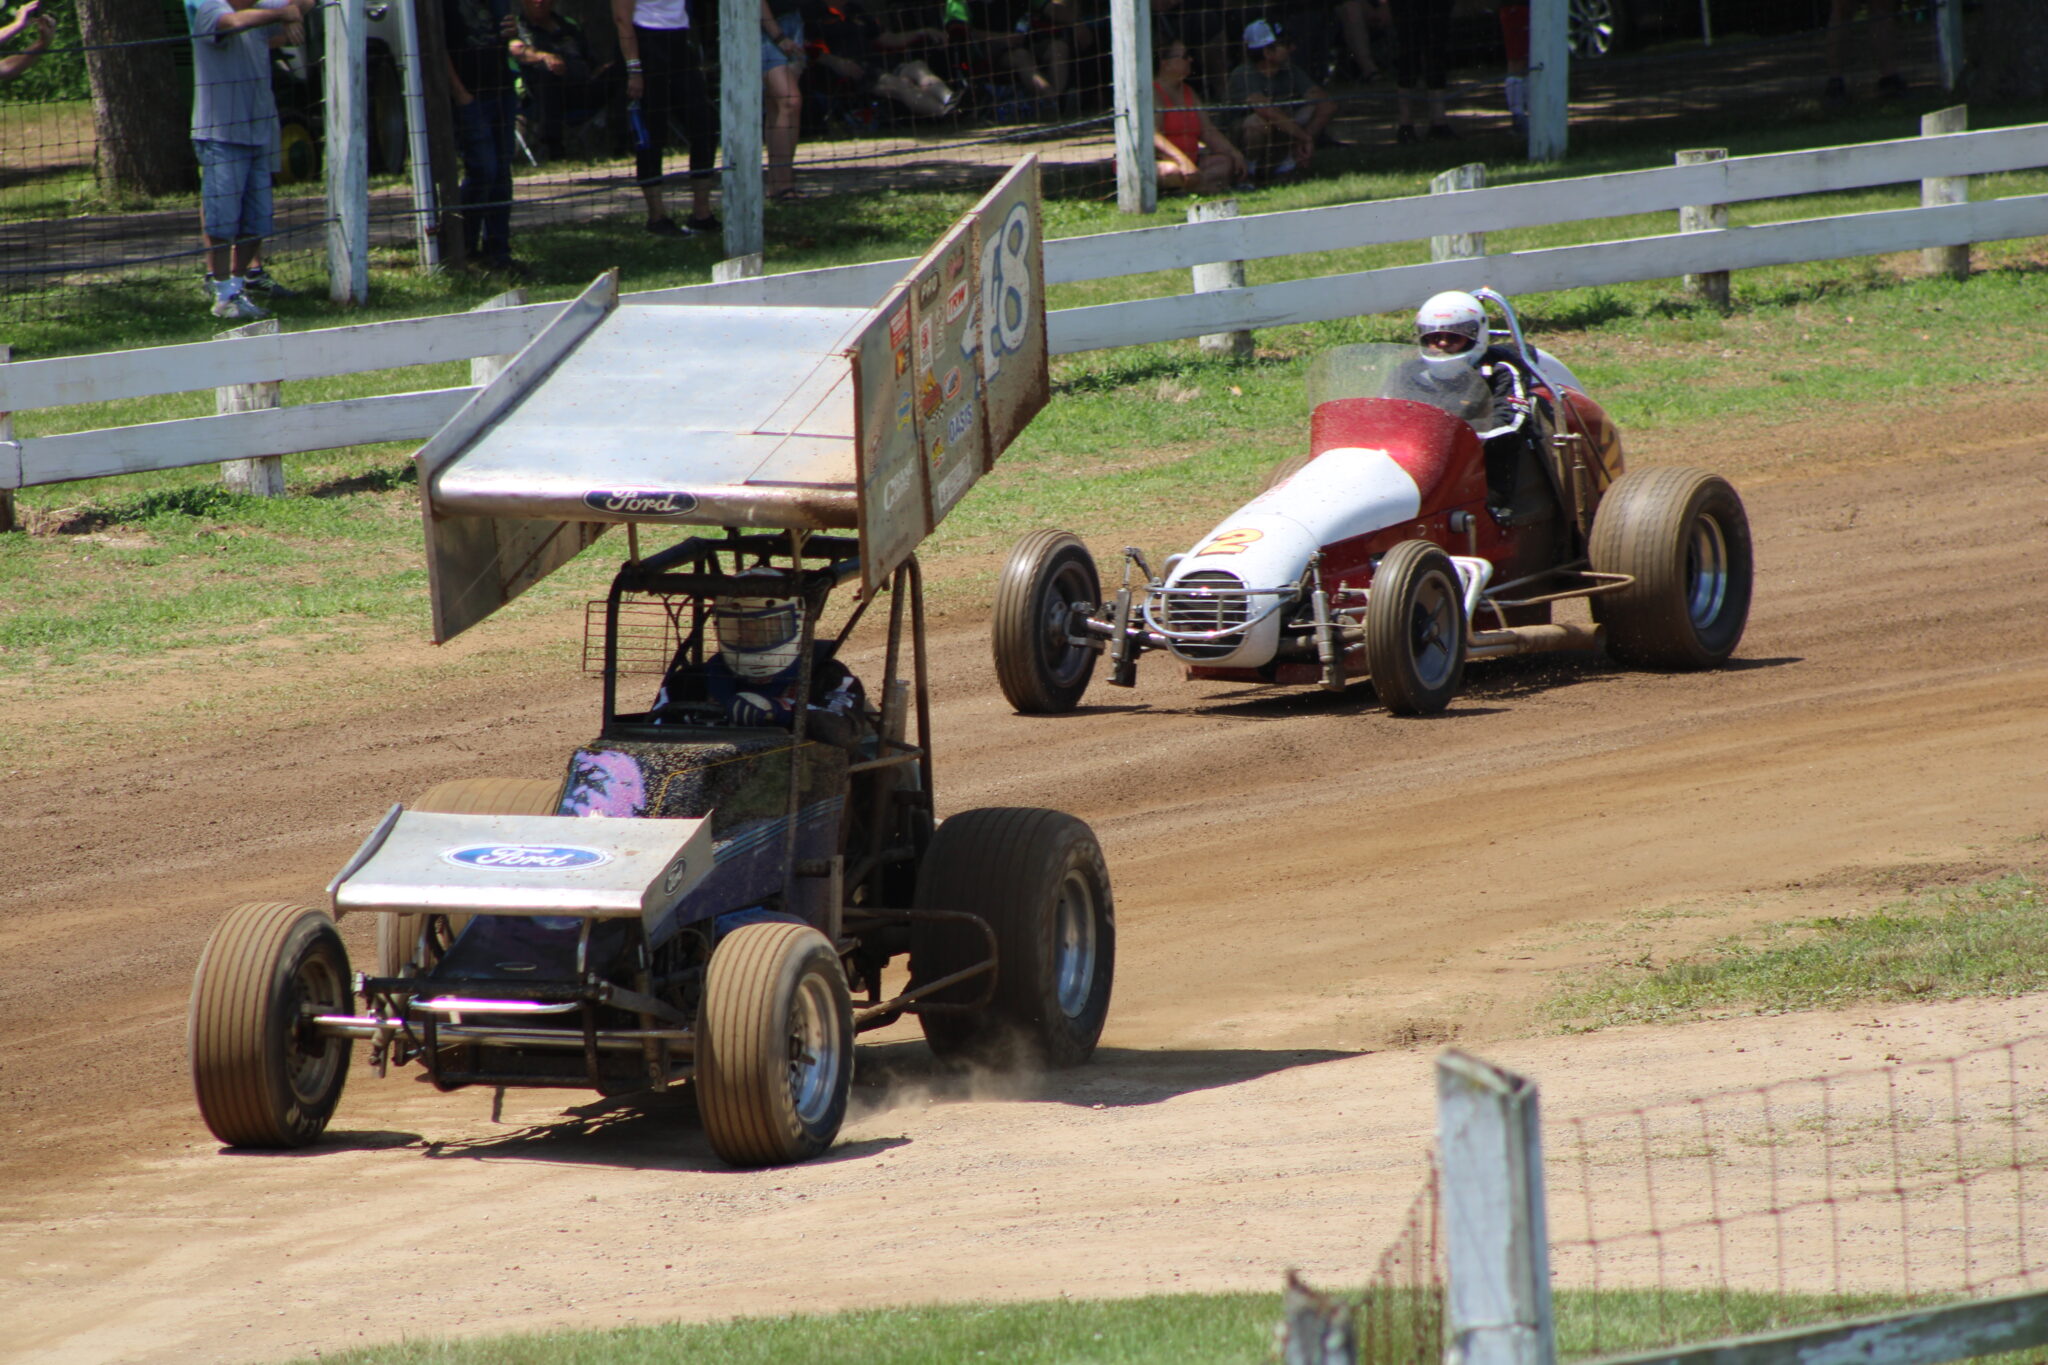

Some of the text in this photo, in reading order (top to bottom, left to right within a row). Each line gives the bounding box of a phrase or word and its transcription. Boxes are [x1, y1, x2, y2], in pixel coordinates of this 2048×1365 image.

[949, 283, 967, 315] TRW
[948, 401, 973, 446] OASIS
[606, 490, 681, 511] Ford
[1194, 528, 1264, 558] 2
[475, 847, 574, 866] Ford
